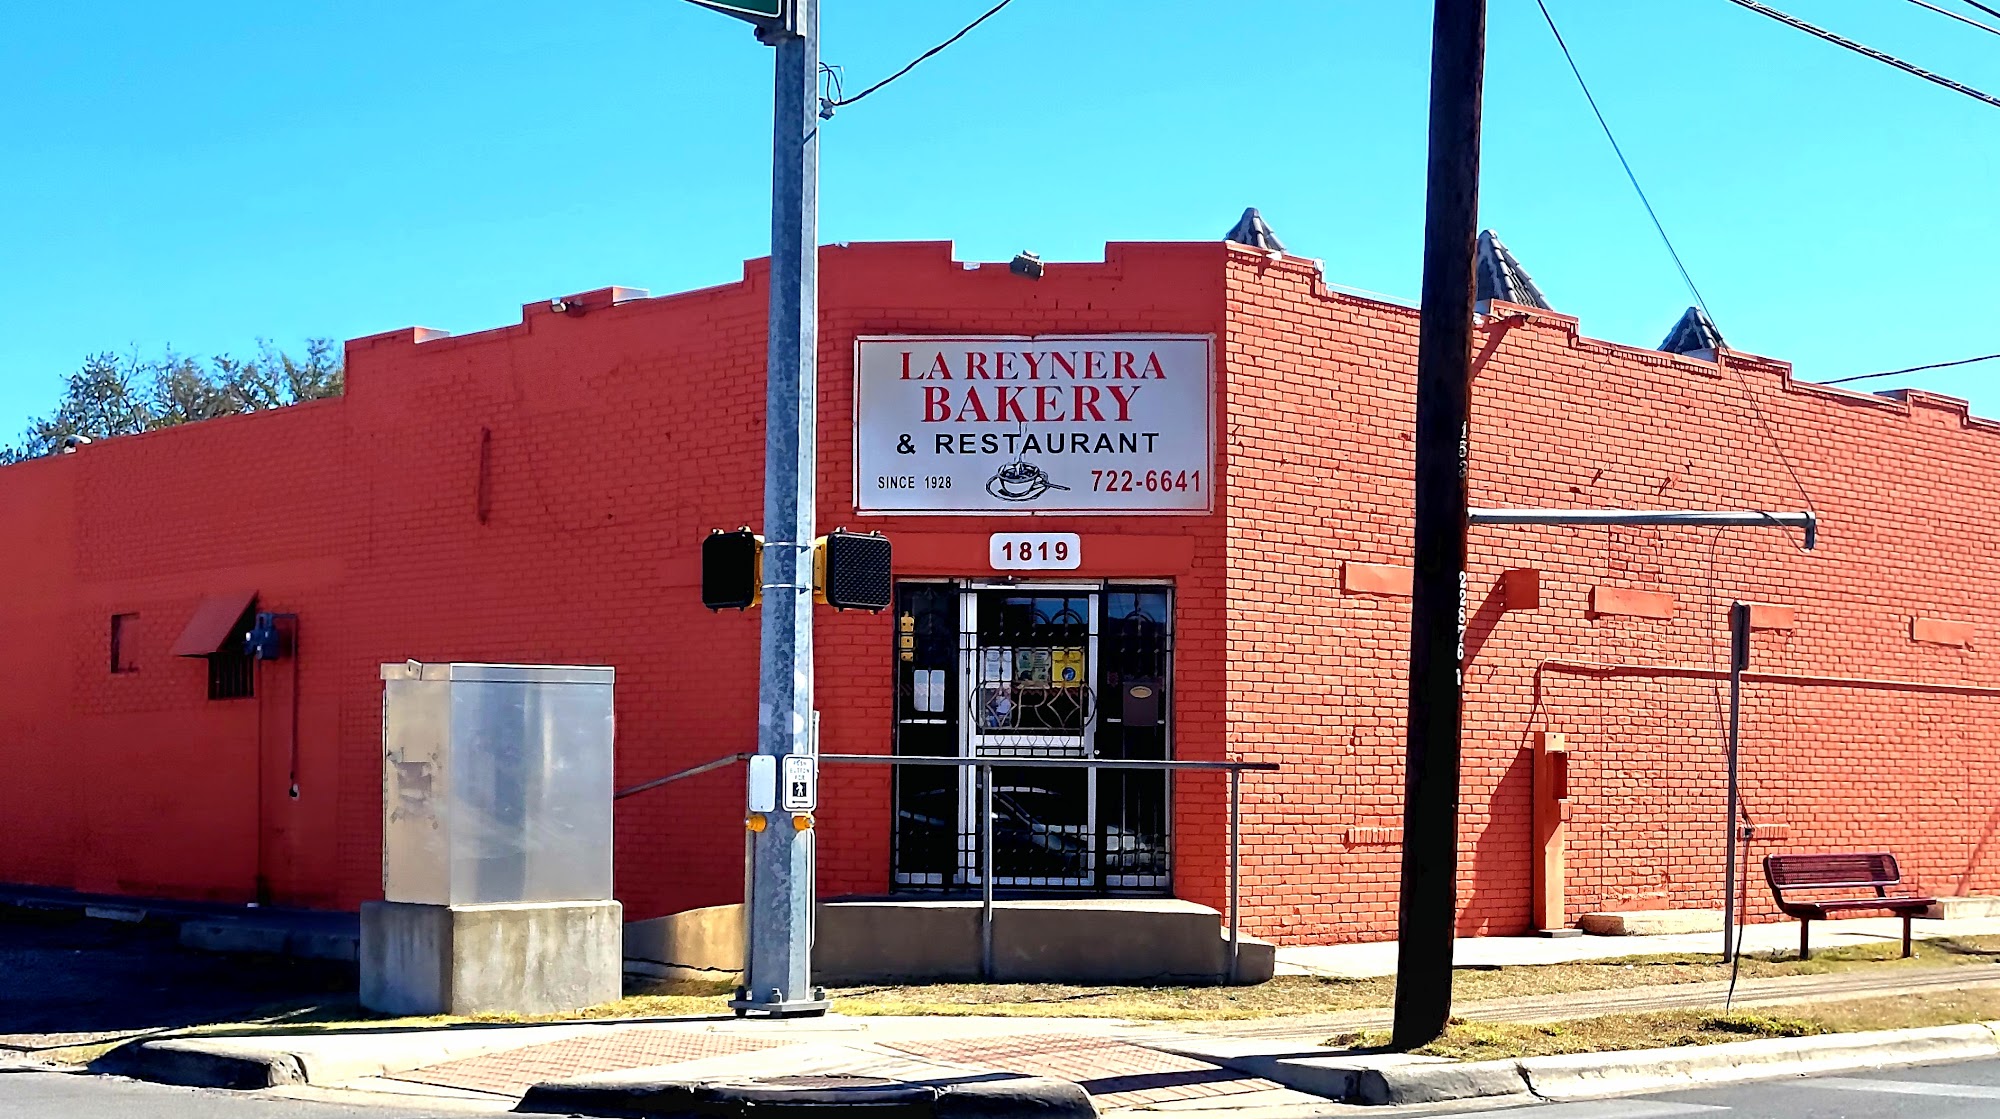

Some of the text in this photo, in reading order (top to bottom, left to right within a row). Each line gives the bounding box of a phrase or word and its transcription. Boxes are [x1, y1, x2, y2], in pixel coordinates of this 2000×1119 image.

[899, 350, 1167, 380] LA REYNERA
[920, 385, 1142, 422] BAKERY
[896, 432, 1159, 454] & RESTAURANT
[877, 476, 951, 489] SINCE 1928
[1091, 469, 1200, 492] 722-6641
[1001, 541, 1068, 561] 1819
